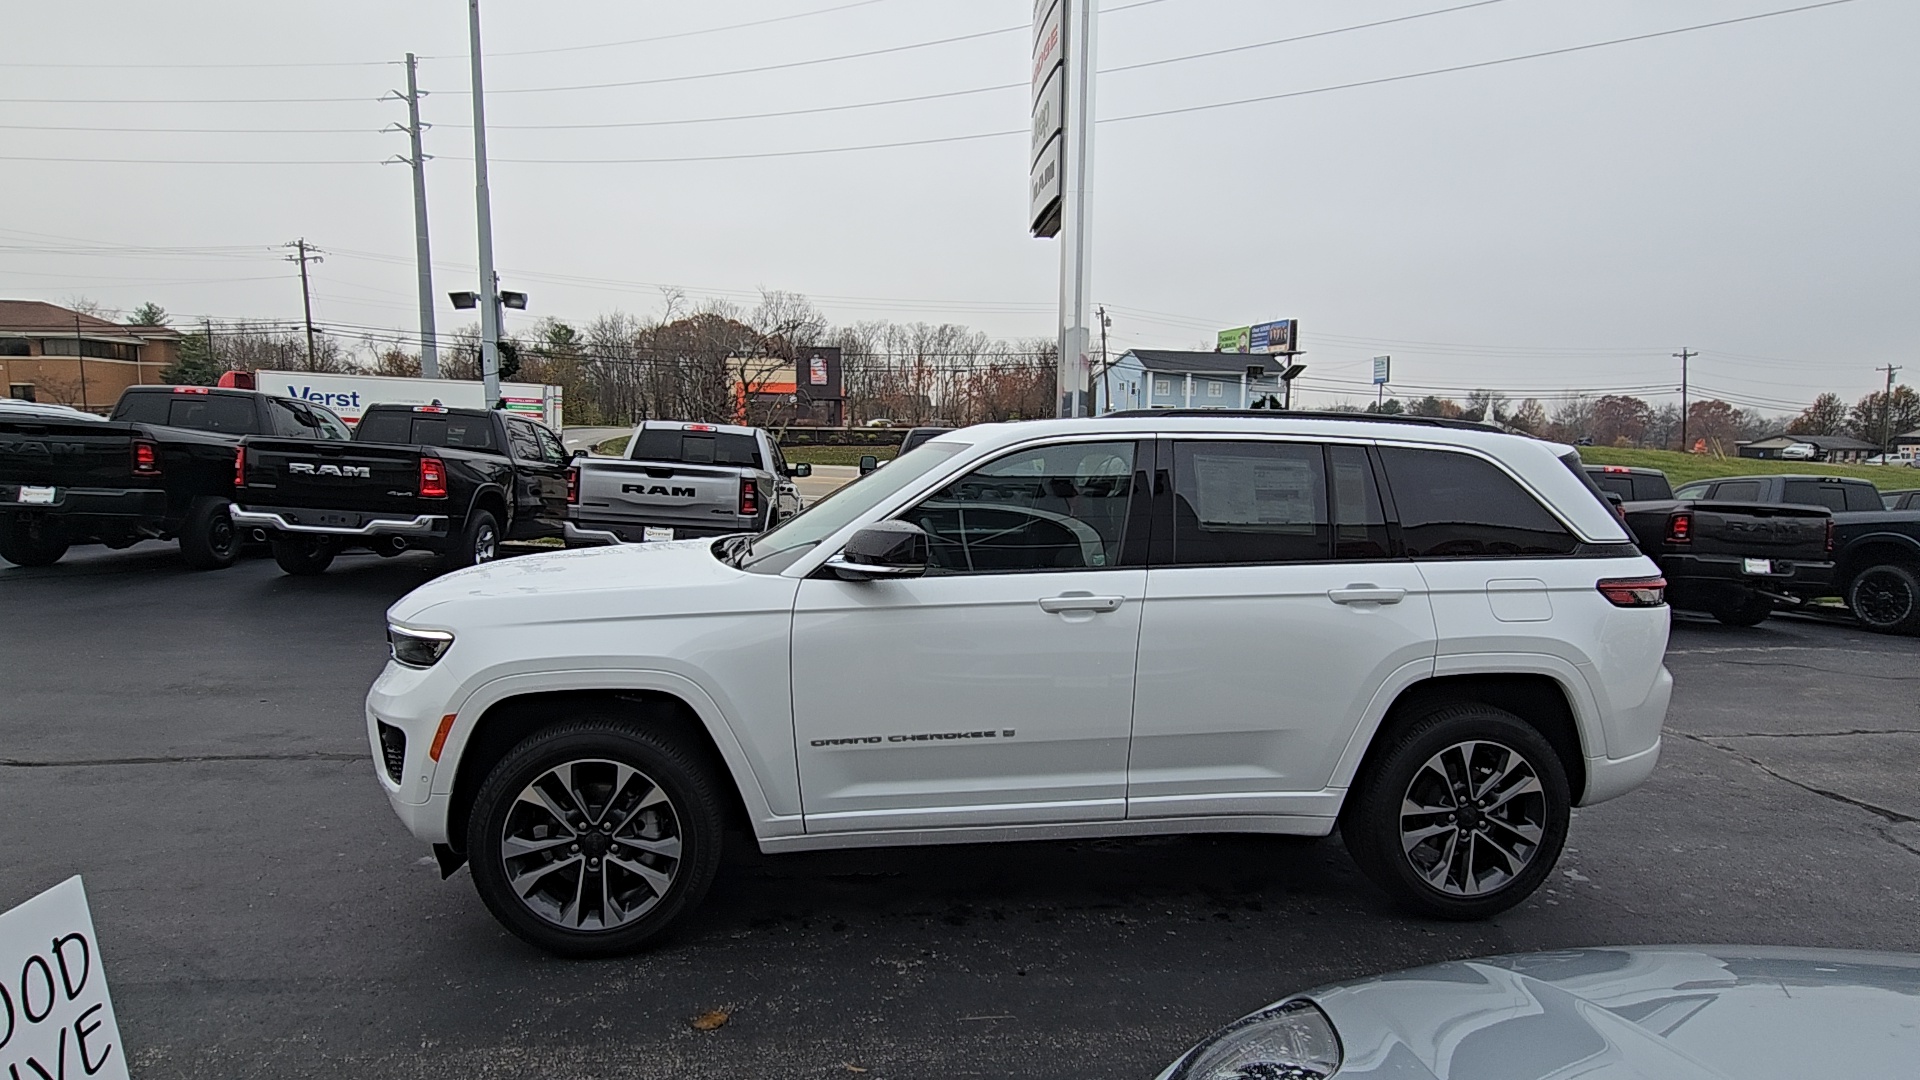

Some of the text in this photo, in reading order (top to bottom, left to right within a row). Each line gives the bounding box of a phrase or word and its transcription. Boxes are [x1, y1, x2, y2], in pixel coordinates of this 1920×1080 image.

[287, 385, 360, 408] Verst
[289, 462, 371, 478] RAM
[621, 483, 696, 498] RAM
[810, 730, 997, 747] GRAND CHEROKEE
[9, 1002, 112, 1080] VE
